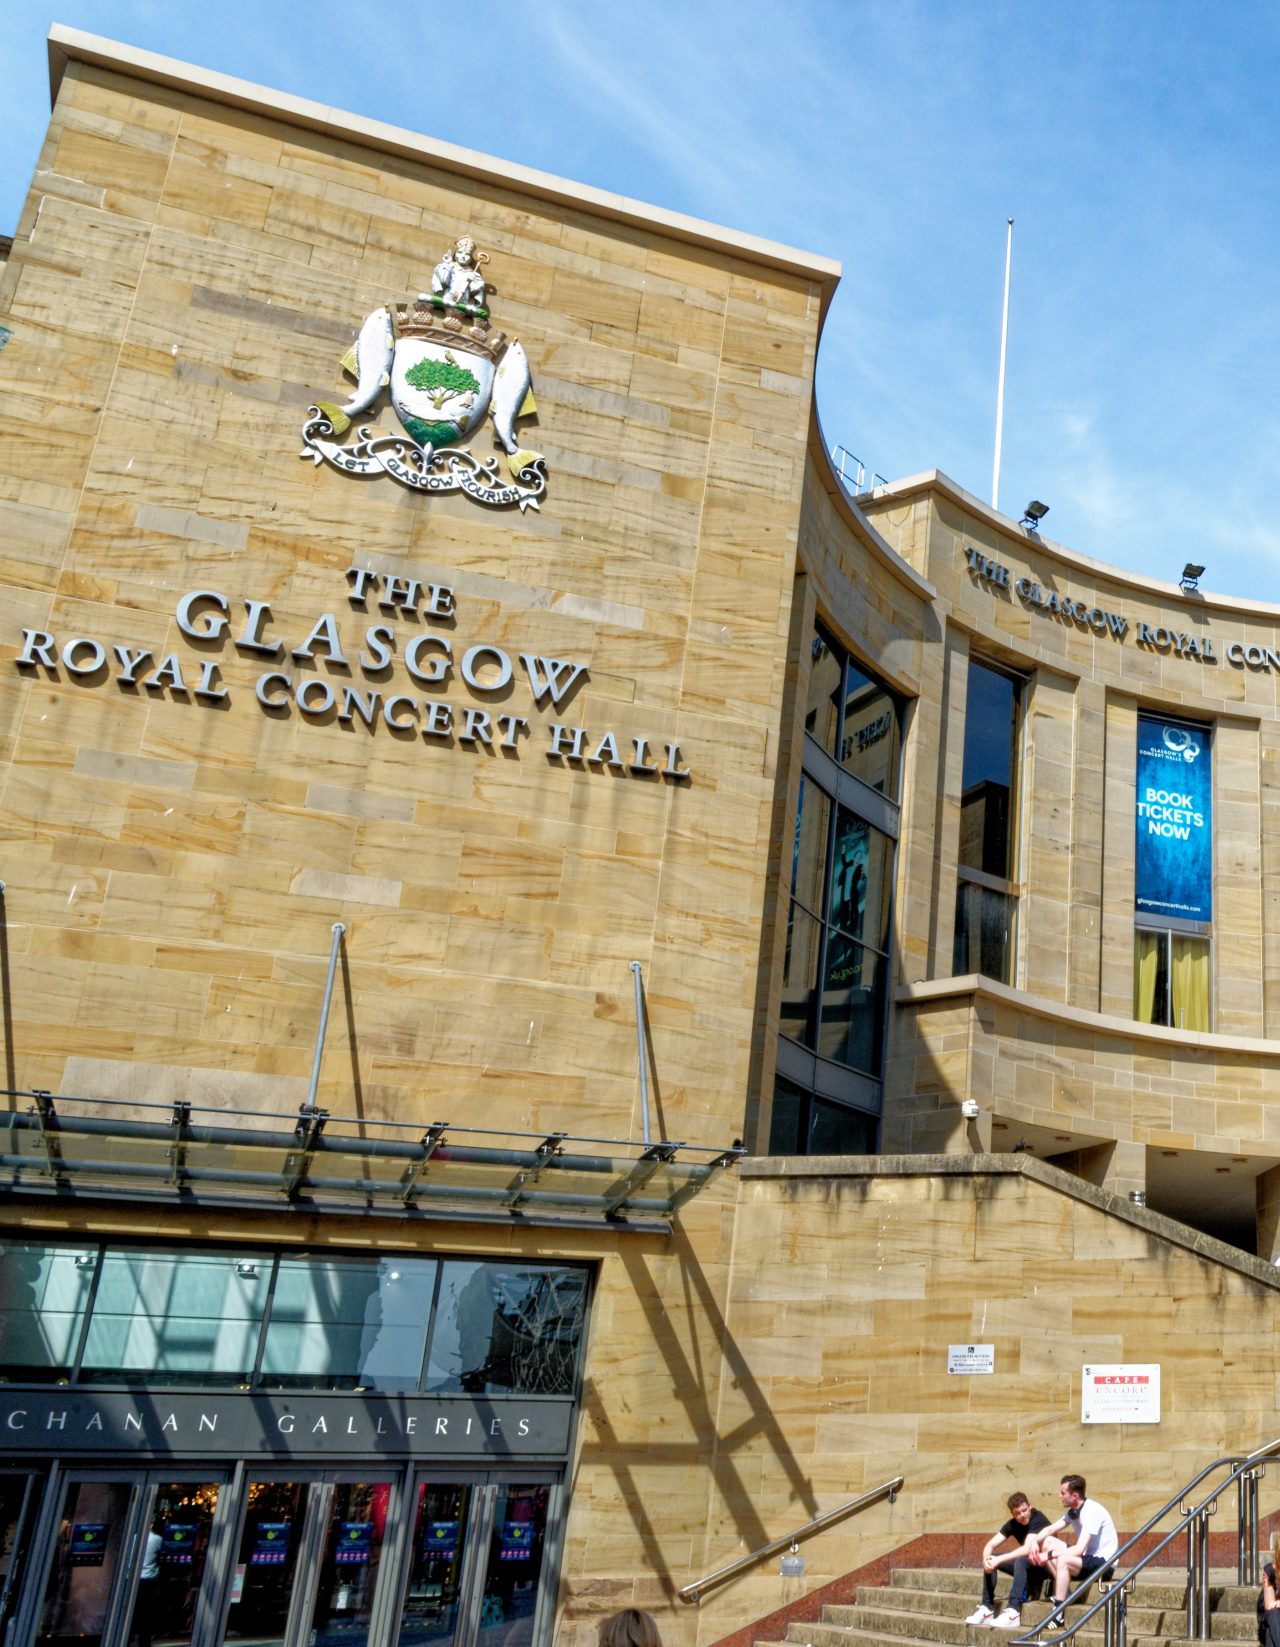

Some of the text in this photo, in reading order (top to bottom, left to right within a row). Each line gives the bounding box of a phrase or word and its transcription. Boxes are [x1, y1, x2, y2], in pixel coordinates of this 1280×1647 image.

[332, 452, 523, 503] LET GLASGOW FLOURISH
[346, 567, 456, 619] THE
[964, 547, 1010, 590] THE
[1015, 577, 1128, 636] GLASGOW
[1136, 621, 1217, 659] ROYAL
[175, 589, 591, 705] GLASGOW
[14, 627, 691, 779] ROYAL CONCERT HALL
[1139, 749, 1182, 762] CONCERT HALLS
[1136, 802, 1204, 827] TICKETS
[1146, 787, 1193, 809] BOOK
[1148, 820, 1191, 840] NOW
[7, 1410, 530, 1436] CHANAN GALLERIES
